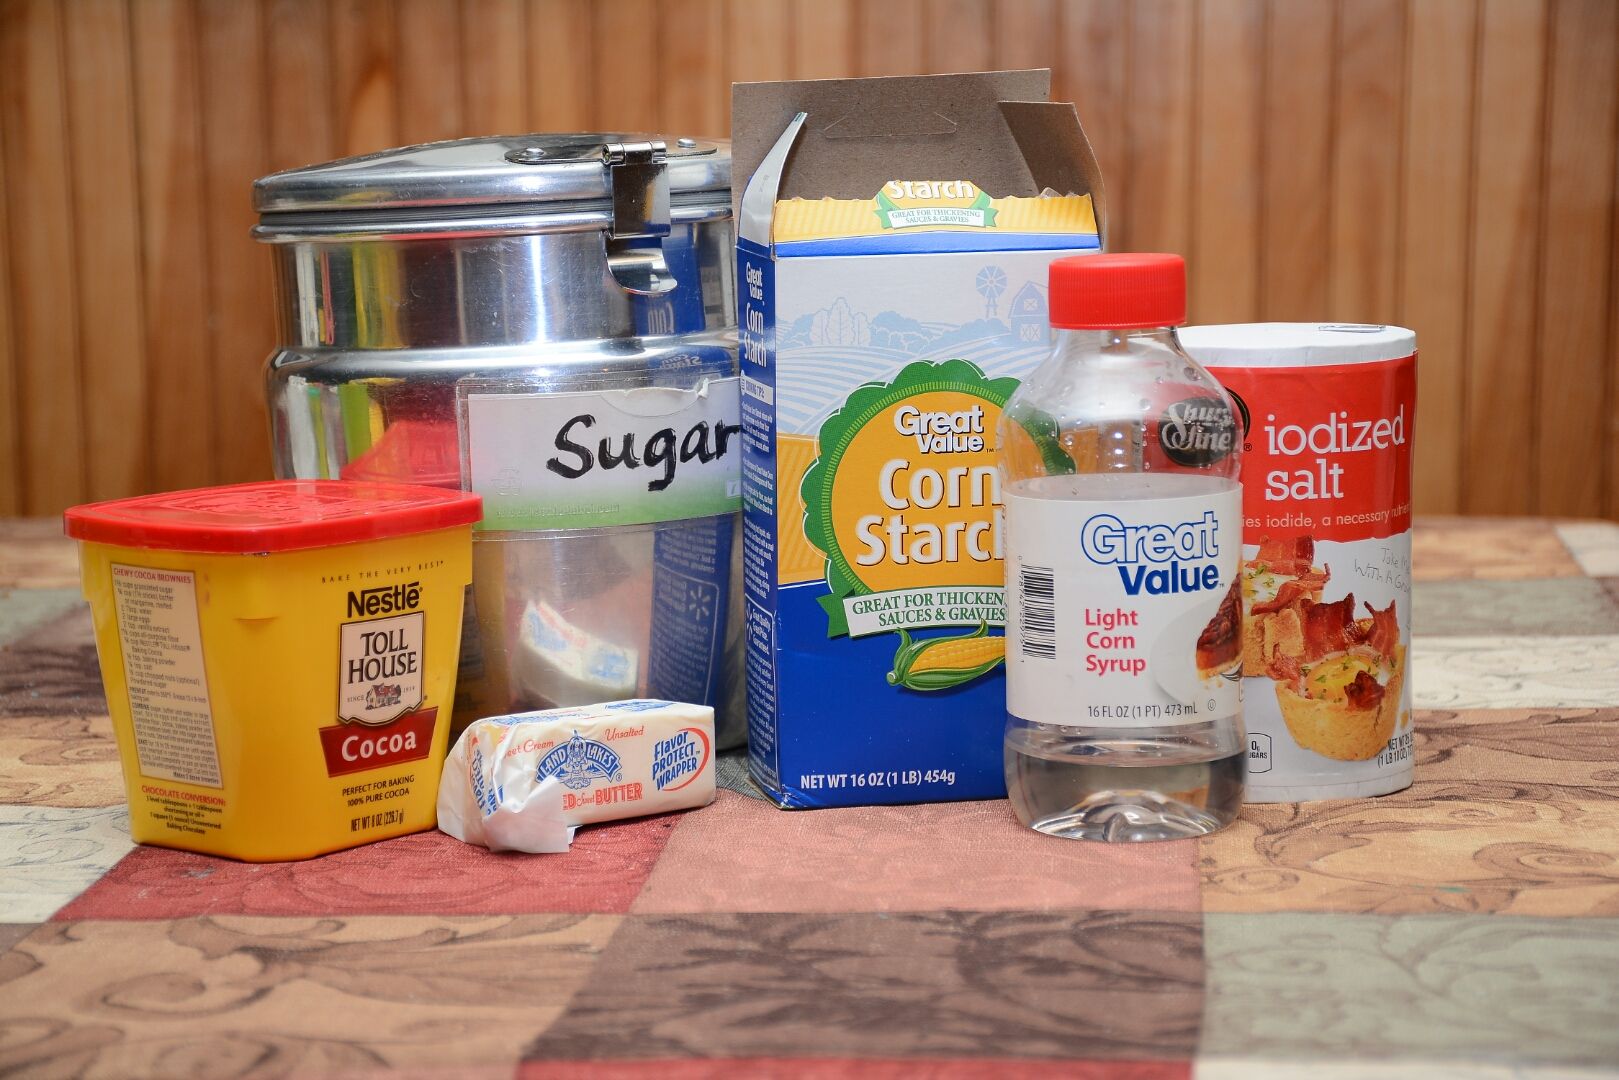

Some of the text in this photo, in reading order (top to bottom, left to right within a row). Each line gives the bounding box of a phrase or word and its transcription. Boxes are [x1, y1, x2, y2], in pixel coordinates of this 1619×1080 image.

[890, 180, 975, 199] Starch
[892, 208, 980, 218] GREAT FOR THICKENING
[746, 261, 763, 288] Great
[750, 283, 763, 300] Value
[746, 302, 764, 335] Corn
[744, 331, 767, 368] Starch
[893, 404, 985, 436] Great
[1264, 403, 1405, 456] iodized
[546, 413, 741, 492] Sugar
[915, 432, 985, 454] Value
[878, 458, 1003, 511] Corn
[1265, 458, 1345, 501] salt
[1266, 513, 1317, 529] iodide,
[1322, 516, 1331, 526] a
[1336, 509, 1390, 526] necessary
[1081, 510, 1219, 566] Great
[113, 568, 192, 584] CHEWY COCOA BROWNIES
[322, 574, 351, 584] BAKE
[359, 570, 380, 579] THE
[386, 566, 412, 576] VERY
[1117, 560, 1220, 596] Value
[347, 581, 421, 618] Nestlé
[852, 592, 1005, 615] GREAT FOR THICKEN
[878, 608, 1006, 627] SAUCES & GRAVIES
[1085, 608, 1139, 631] Light
[360, 628, 409, 656] TOLL
[1086, 632, 1136, 650] Corn
[348, 651, 418, 684] HOUSE
[1086, 654, 1147, 677] Syrup
[1088, 702, 1198, 719] 16 FL OZ (1 PT) 473 mL
[604, 725, 645, 741] Unsalted
[341, 730, 417, 762] Cocoa
[523, 738, 554, 753] Cream
[654, 731, 689, 761] Flavor
[540, 742, 615, 775] LAND LAKES
[652, 742, 696, 781] PROTECT
[342, 774, 416, 797] PERFECT FOR BAKING
[656, 757, 698, 791] WRAPPER
[800, 770, 956, 790] NET WT 16 OZ (1 LB) 454g
[142, 784, 226, 806] CHOCOLATE CONVERSION:
[347, 788, 410, 808] 100% PURE COCOA
[595, 782, 643, 806] BUTTER
[351, 818, 361, 833] NET
[362, 816, 372, 831] WT
[376, 813, 382, 826] OZ
